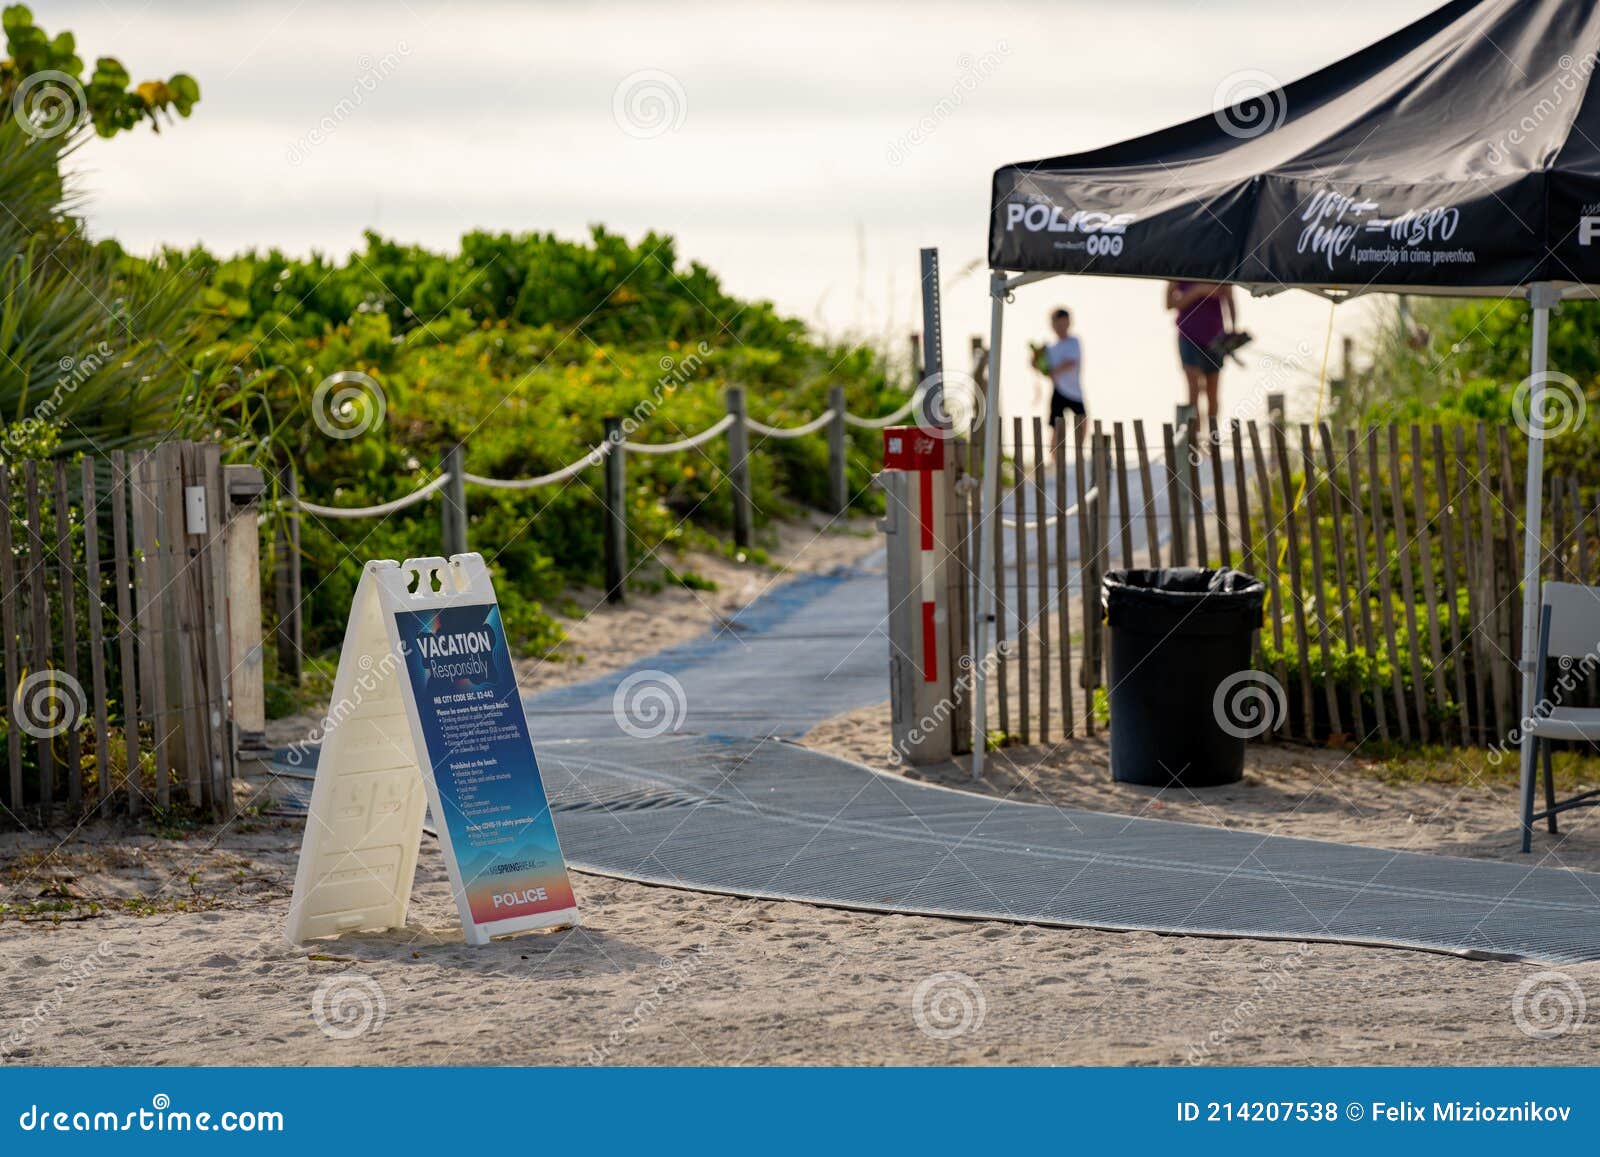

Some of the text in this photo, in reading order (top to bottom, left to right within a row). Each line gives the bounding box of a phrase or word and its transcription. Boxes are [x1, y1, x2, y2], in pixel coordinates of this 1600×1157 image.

[1006, 203, 1137, 234] POLICE
[1350, 245, 1476, 266] A partnership in crime prevention
[416, 631, 492, 658] VACATION
[430, 654, 488, 682] Responsibly
[442, 695, 453, 703] CITY
[453, 693, 466, 702] CODE
[493, 887, 548, 907] POLICE
